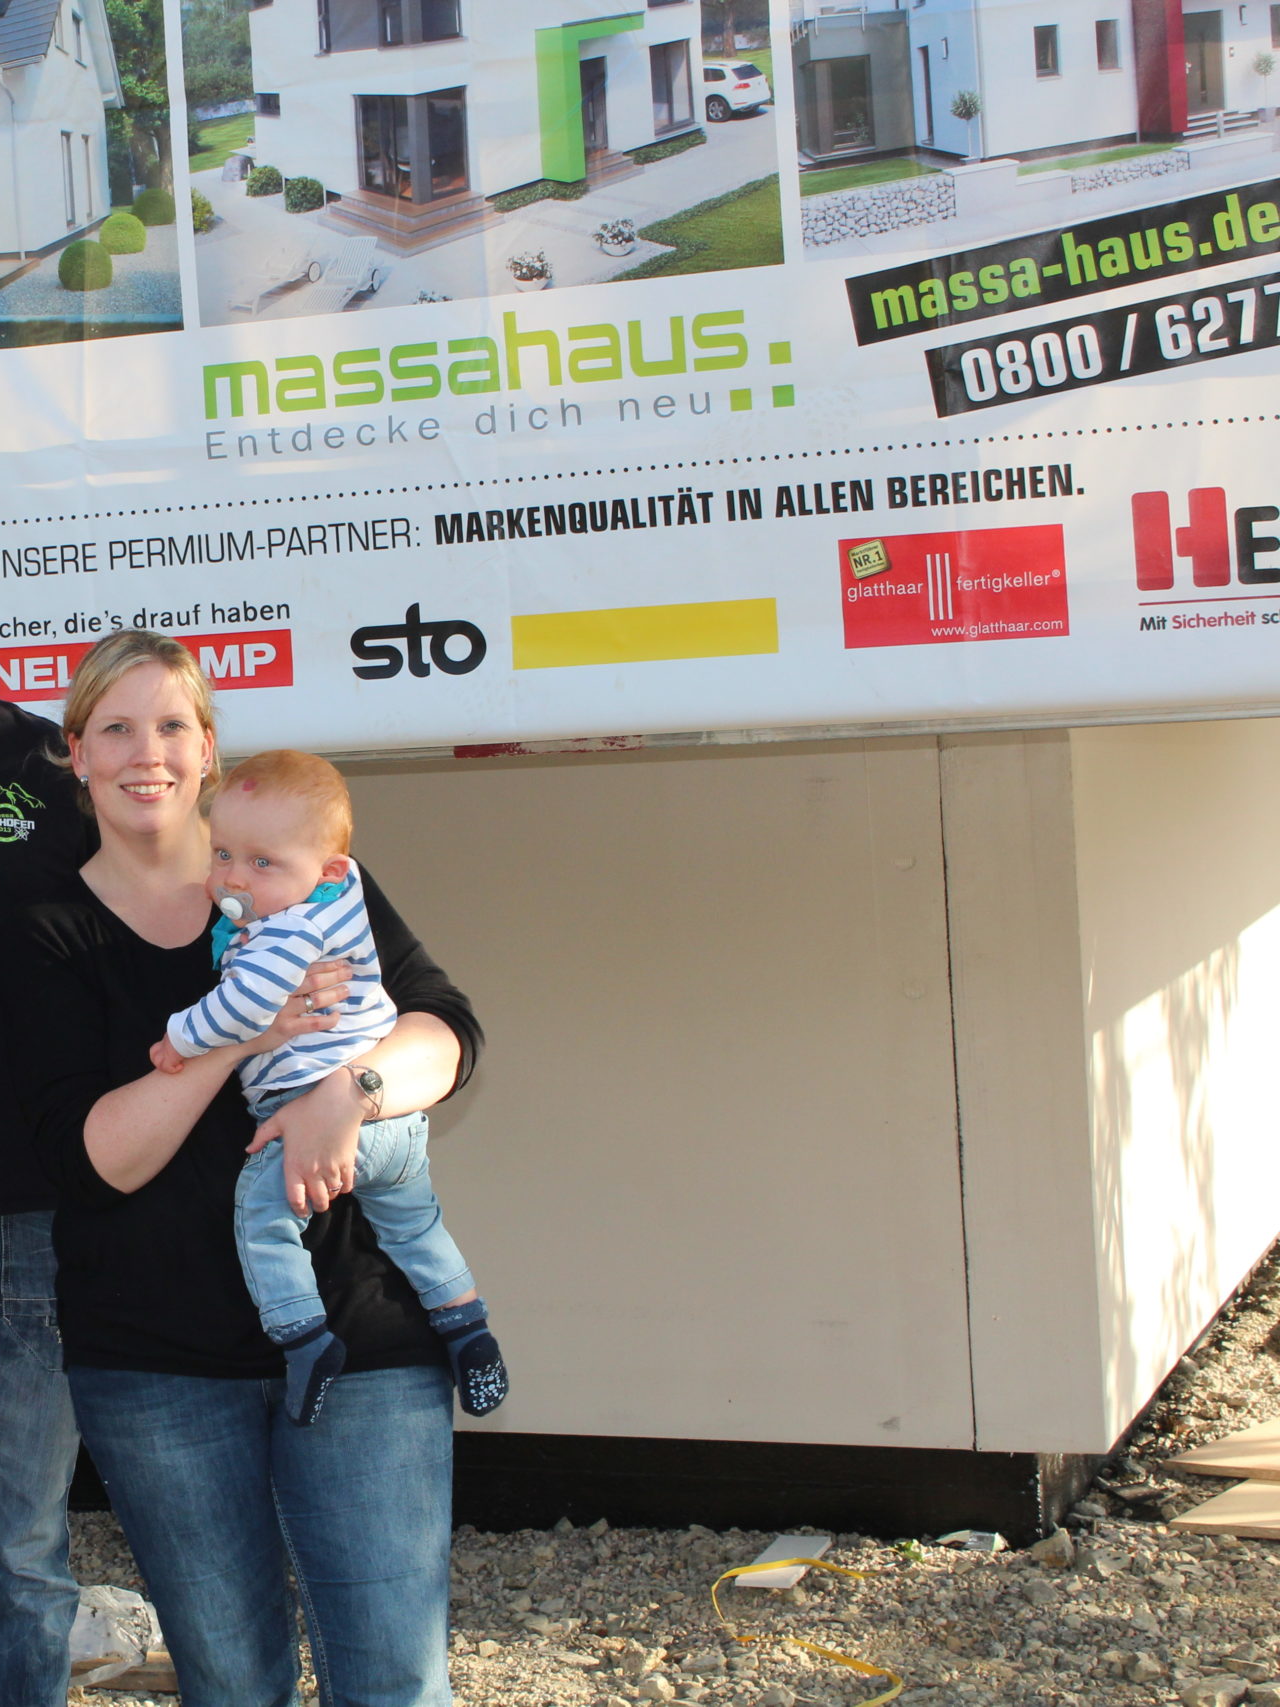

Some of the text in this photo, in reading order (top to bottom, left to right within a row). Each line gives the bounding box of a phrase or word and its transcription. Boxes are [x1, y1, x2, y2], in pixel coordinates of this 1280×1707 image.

[870, 194, 1280, 329] massa-haus.de
[203, 310, 748, 419] massahaus
[960, 324, 1103, 402] 0800
[206, 391, 711, 459] Entdecke dich neu
[109, 517, 421, 570] PERMIUM-PARTNER:
[434, 486, 714, 545] MARKENQUALITÄT
[726, 488, 762, 521] IN
[775, 479, 874, 518] ALLEN
[887, 463, 1085, 509] BEREICHEN.
[133, 604, 201, 629] drauf
[211, 600, 291, 625] haben
[847, 580, 923, 602] glatthaar
[1140, 610, 1280, 631] Mit Sicherheit sc
[350, 602, 487, 680] sto
[931, 618, 1063, 638] www.glatthaar.com
